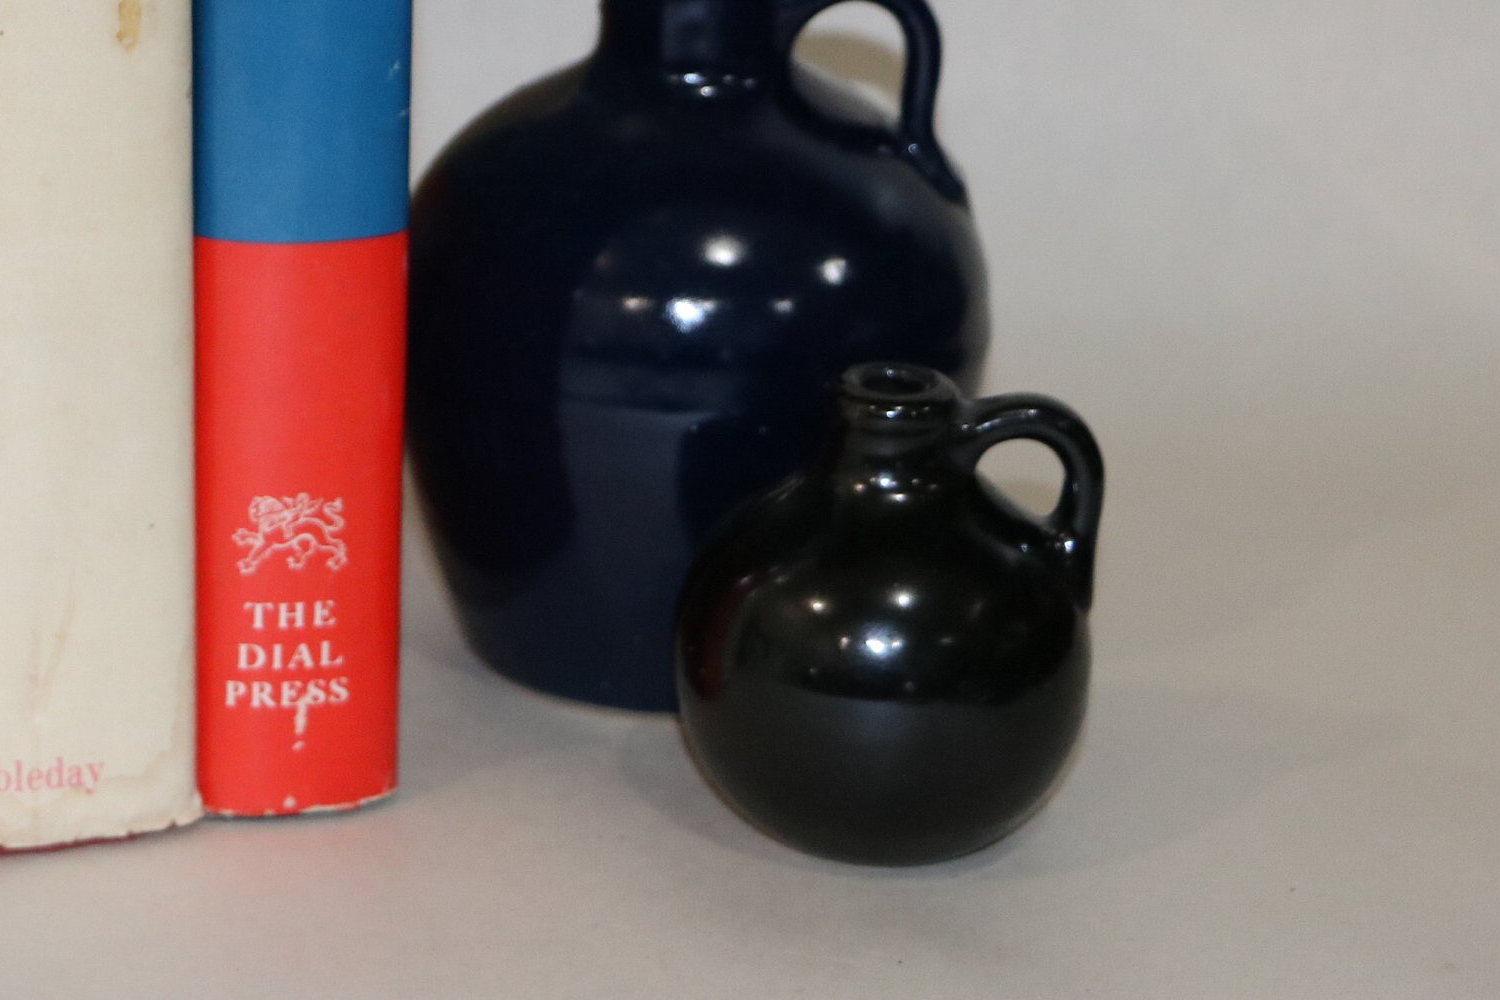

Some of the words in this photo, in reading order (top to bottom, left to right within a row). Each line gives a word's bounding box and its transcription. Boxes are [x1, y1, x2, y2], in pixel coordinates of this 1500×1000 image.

[243, 600, 338, 630] THE
[236, 639, 344, 671] DIAL
[224, 676, 350, 709] PRESS
